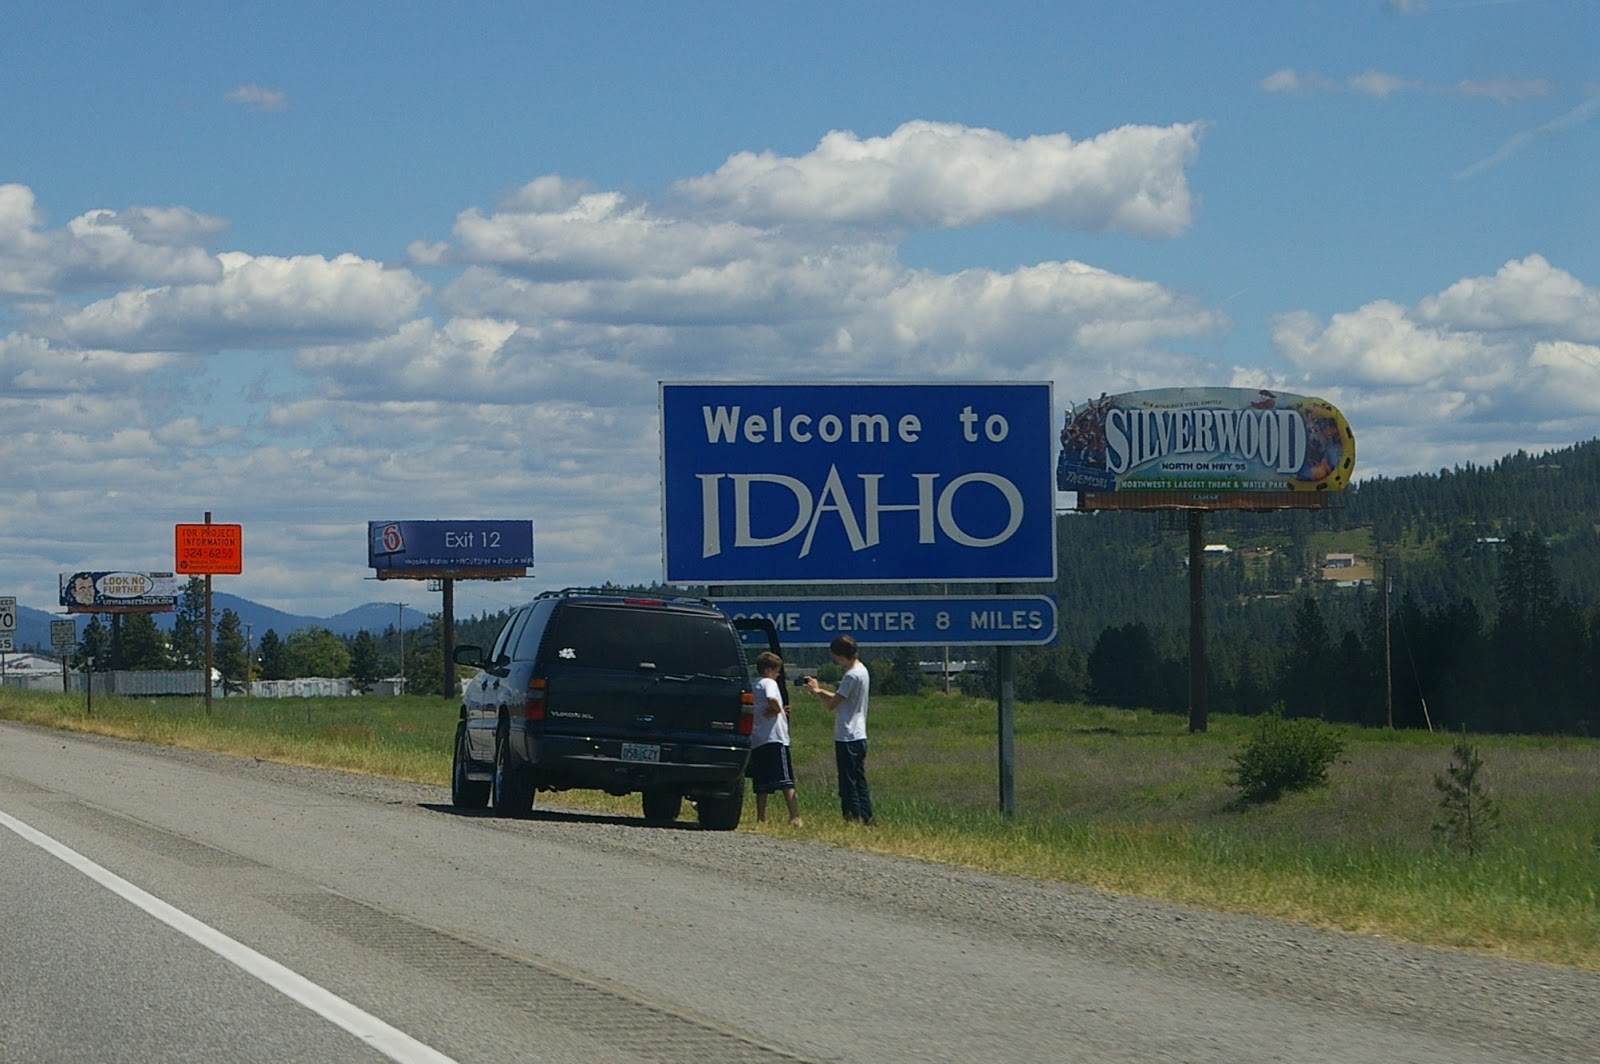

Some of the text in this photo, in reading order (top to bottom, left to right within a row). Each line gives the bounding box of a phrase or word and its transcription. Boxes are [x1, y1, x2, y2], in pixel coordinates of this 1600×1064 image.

[702, 405, 1009, 444] Welcome to
[1104, 408, 1307, 475] SILVERWOOD
[1162, 462, 1246, 471] NORTH ON HWY 95
[1174, 481, 1205, 489] LARGEST
[1208, 481, 1231, 489] THEME
[1233, 481, 1240, 489] &
[1242, 480, 1266, 489] WATER
[1268, 480, 1288, 489] PARK
[695, 463, 1024, 559] IDAHO
[182, 529, 235, 538] FOR PROJECT
[383, 525, 402, 551] 6
[445, 531, 501, 548] Exit 12
[183, 538, 236, 546] INFORMATION
[103, 577, 146, 585] LOOK NO
[103, 586, 146, 594] FURTHER
[820, 612, 915, 632] CENTER
[935, 612, 951, 630] 8
[970, 610, 1043, 630] MILES
